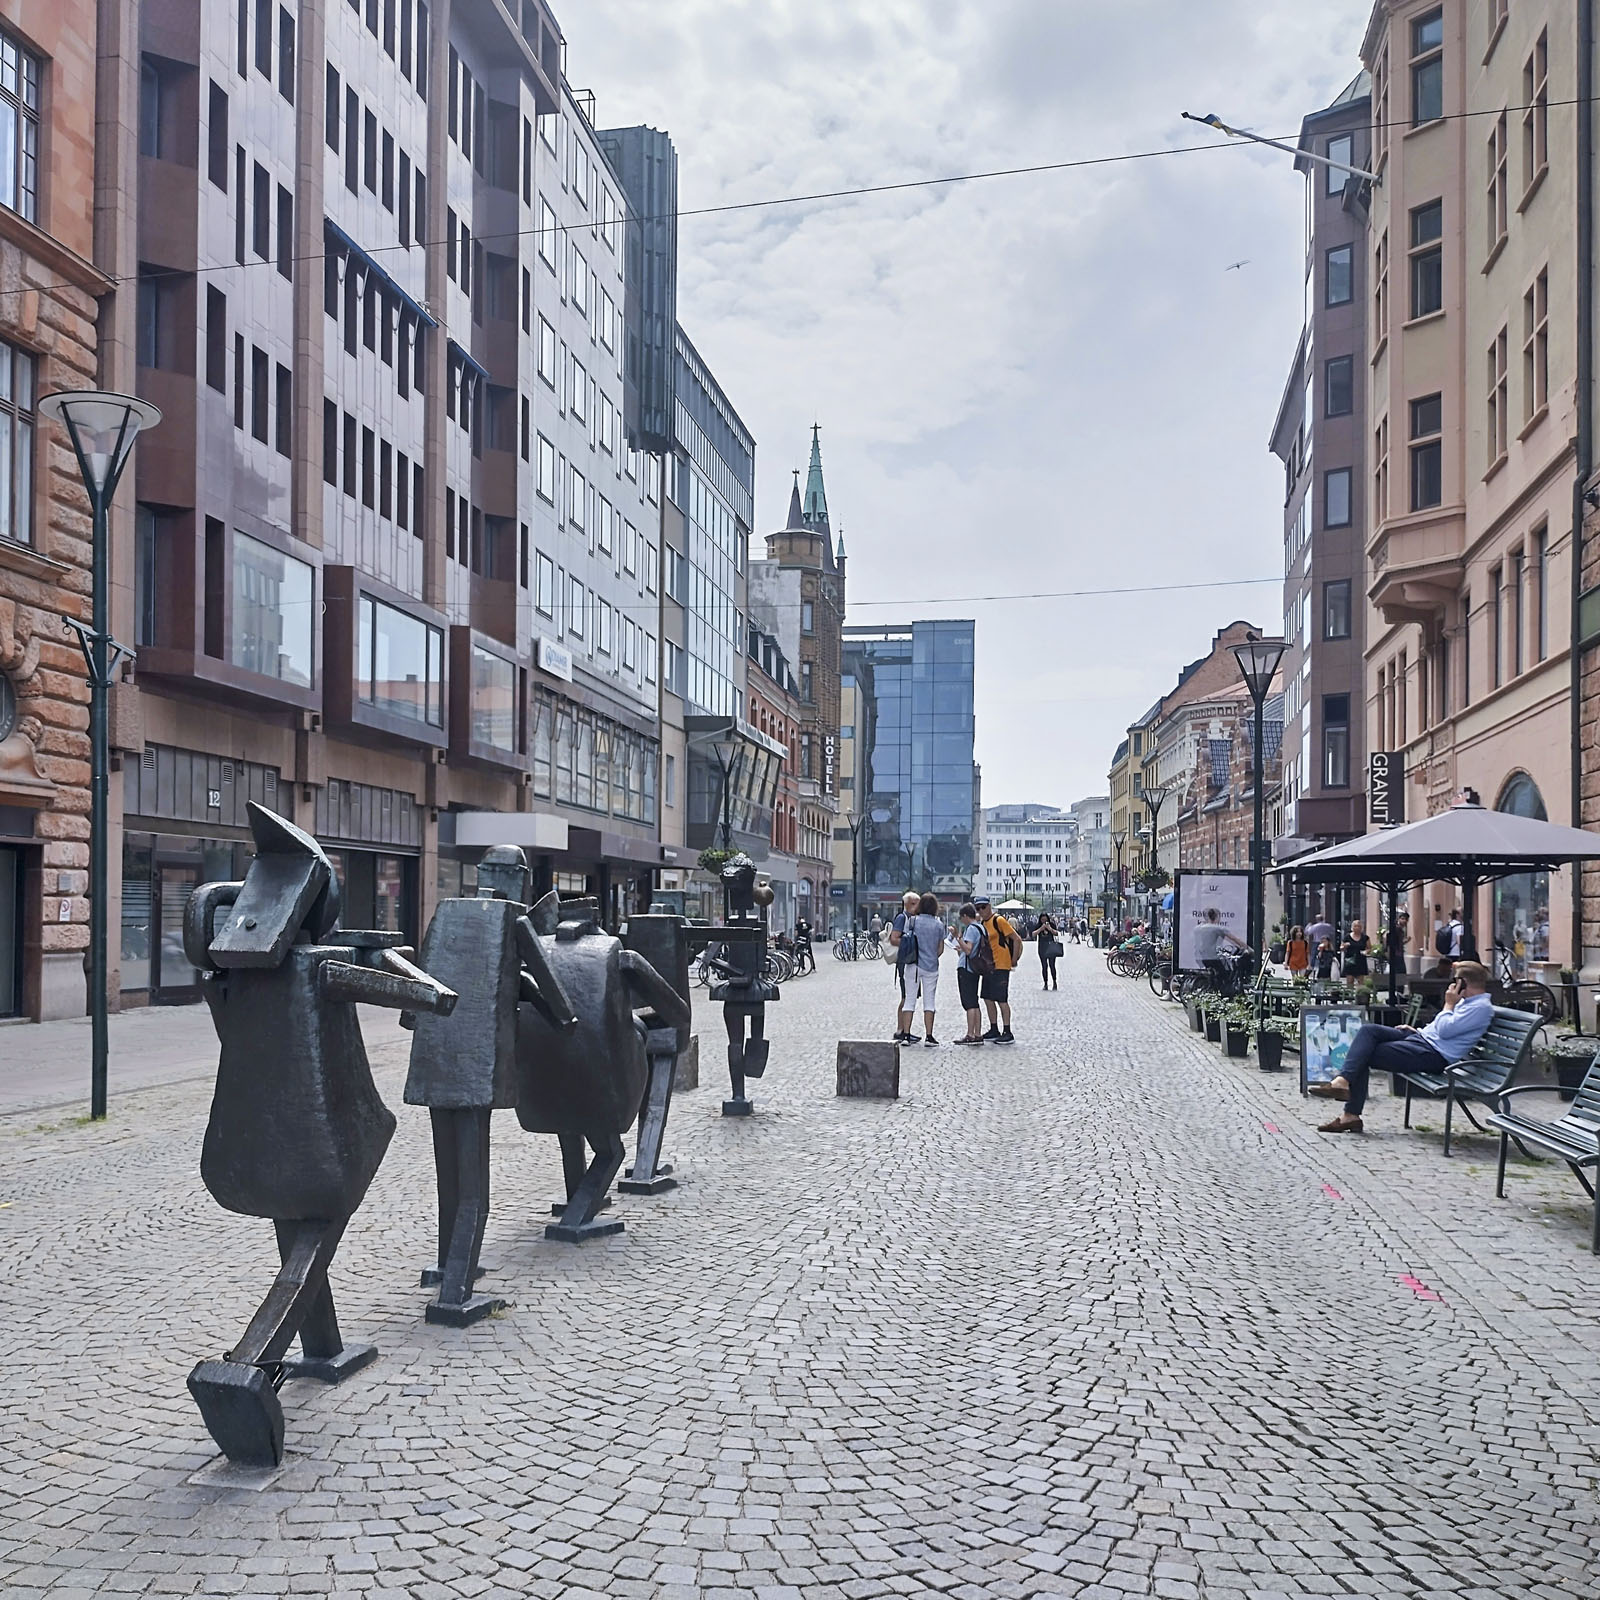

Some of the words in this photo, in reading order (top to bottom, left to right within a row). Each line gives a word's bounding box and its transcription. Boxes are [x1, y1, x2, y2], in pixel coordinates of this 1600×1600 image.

[825, 736, 834, 794] HOTELL
[1373, 753, 1388, 822] GRANIT
[208, 790, 220, 807] 12
